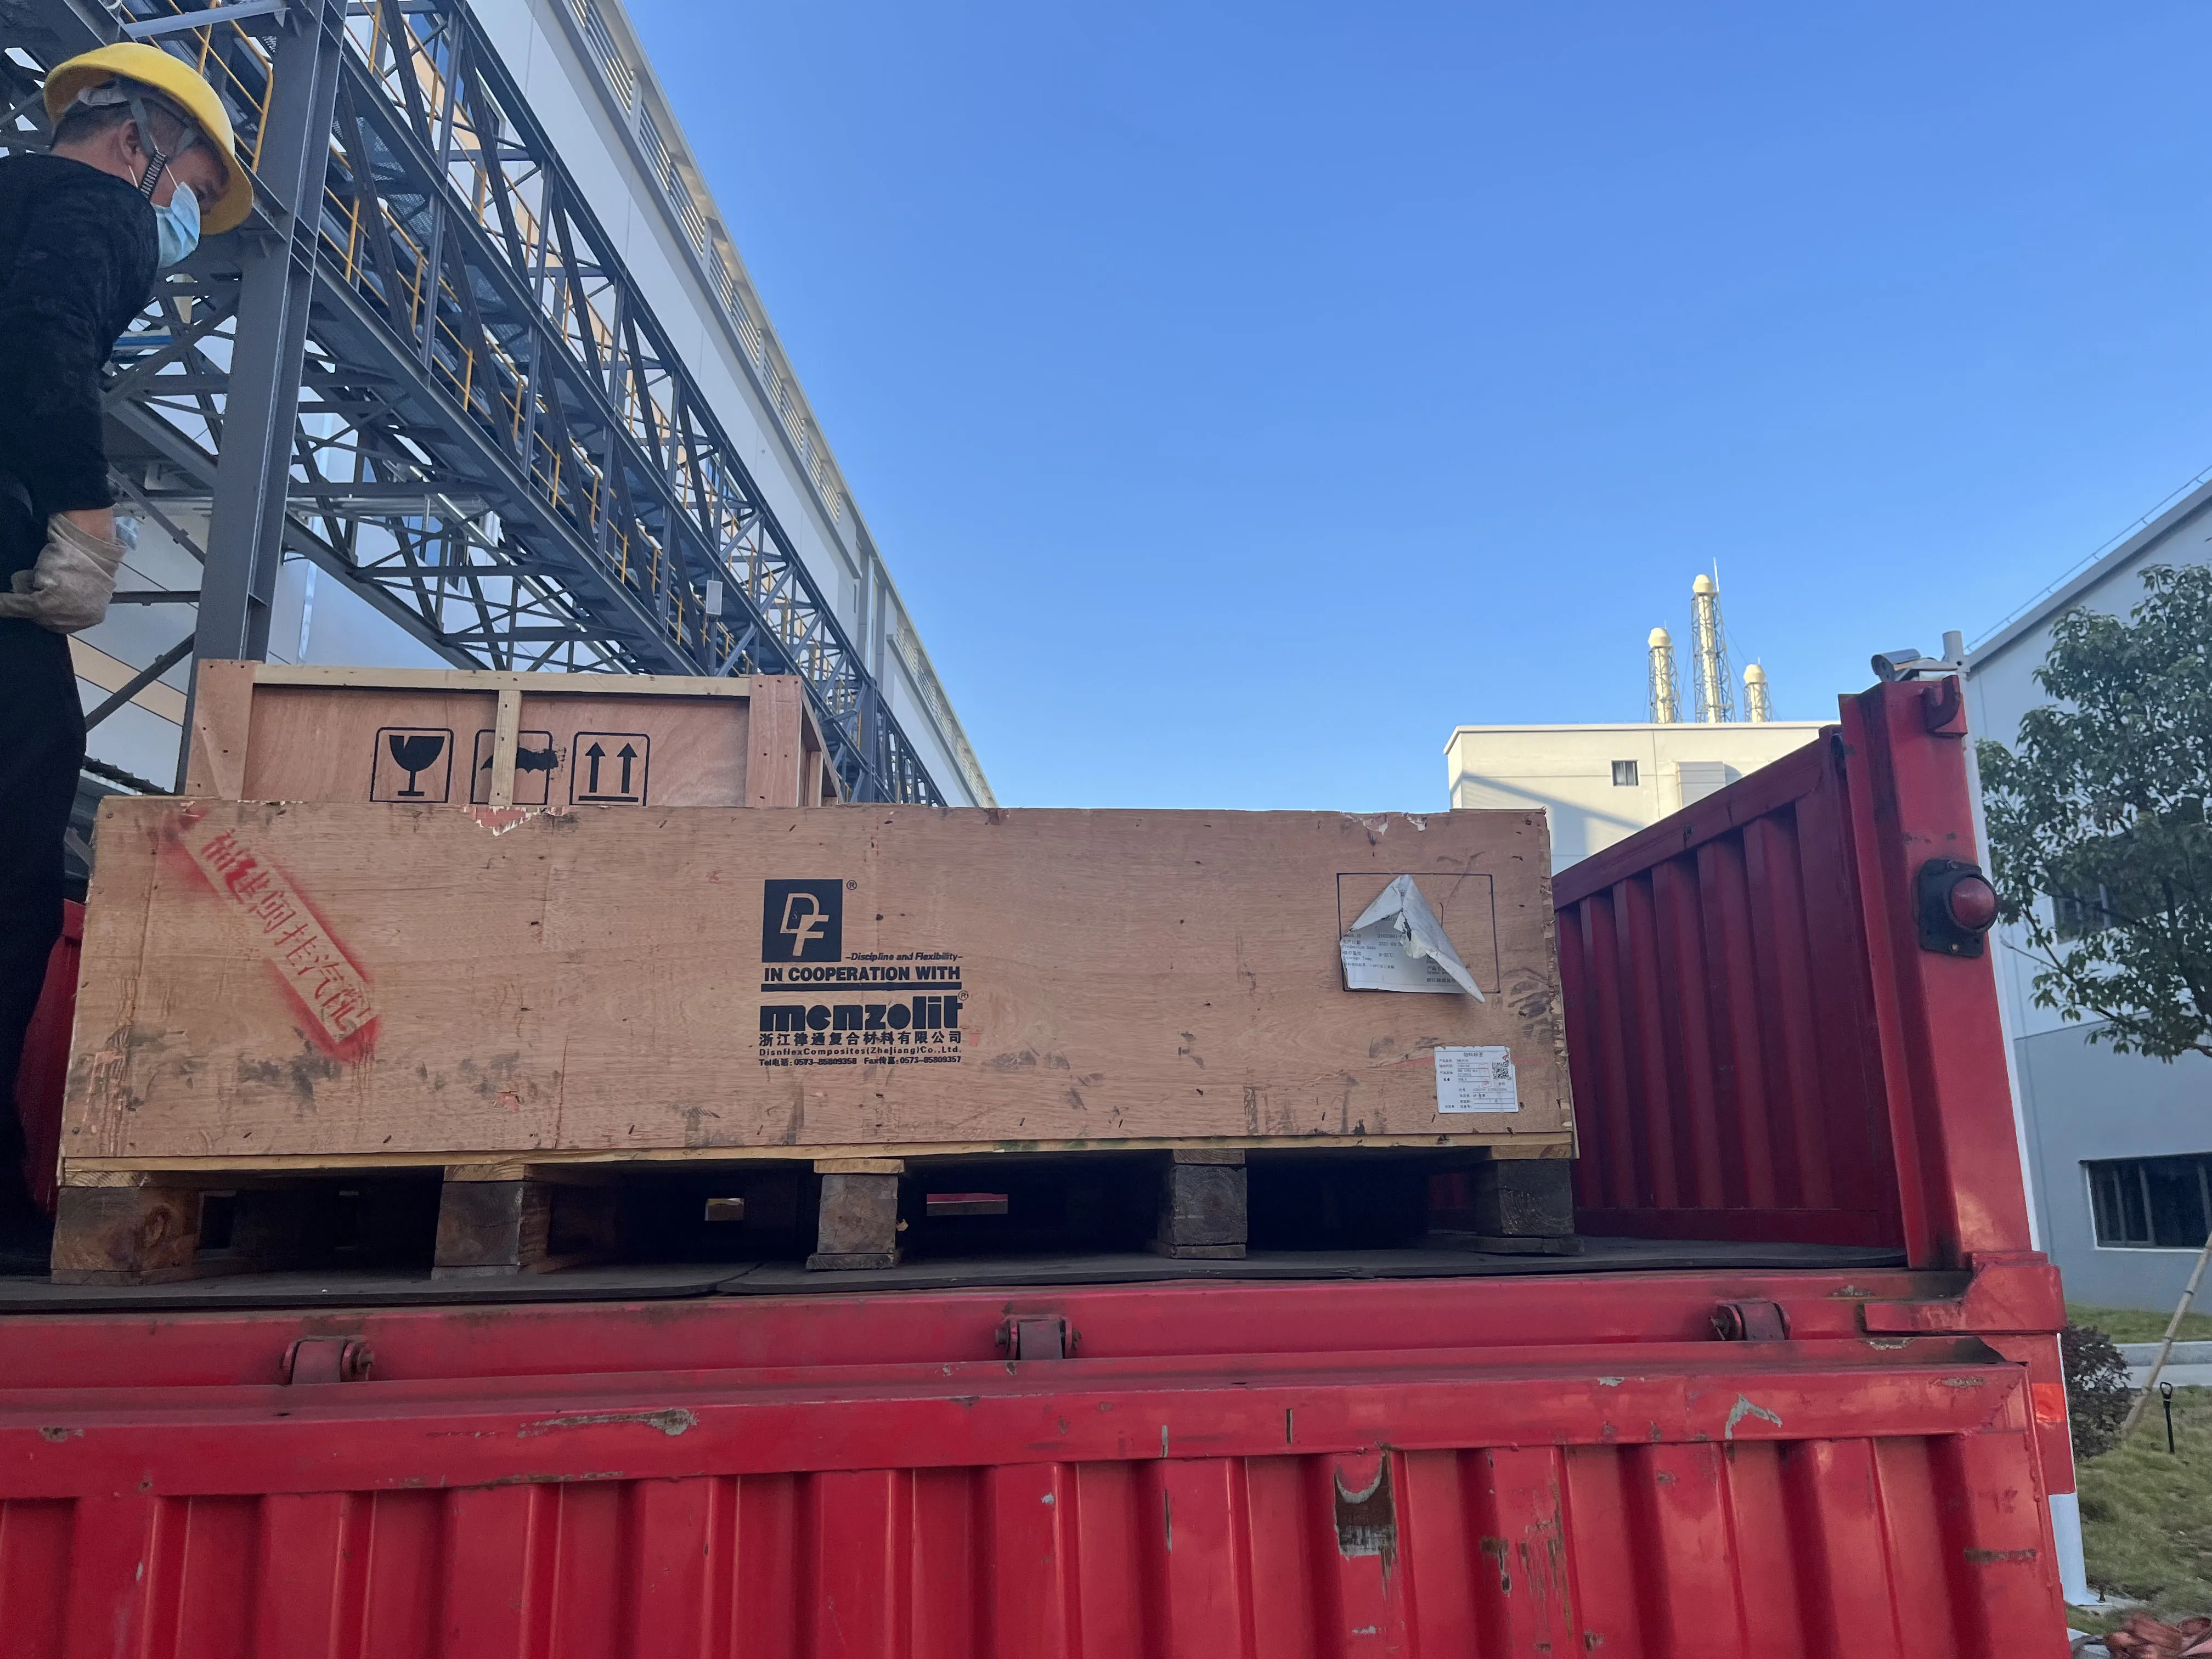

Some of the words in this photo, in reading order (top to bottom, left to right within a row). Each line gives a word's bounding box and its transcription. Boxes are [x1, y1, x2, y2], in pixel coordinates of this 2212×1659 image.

[896, 952, 913, 961] and
[764, 967, 783, 981] IN
[788, 966, 911, 981] COOPERATION
[916, 966, 961, 980] WITH
[759, 995, 963, 1032] menzolit
